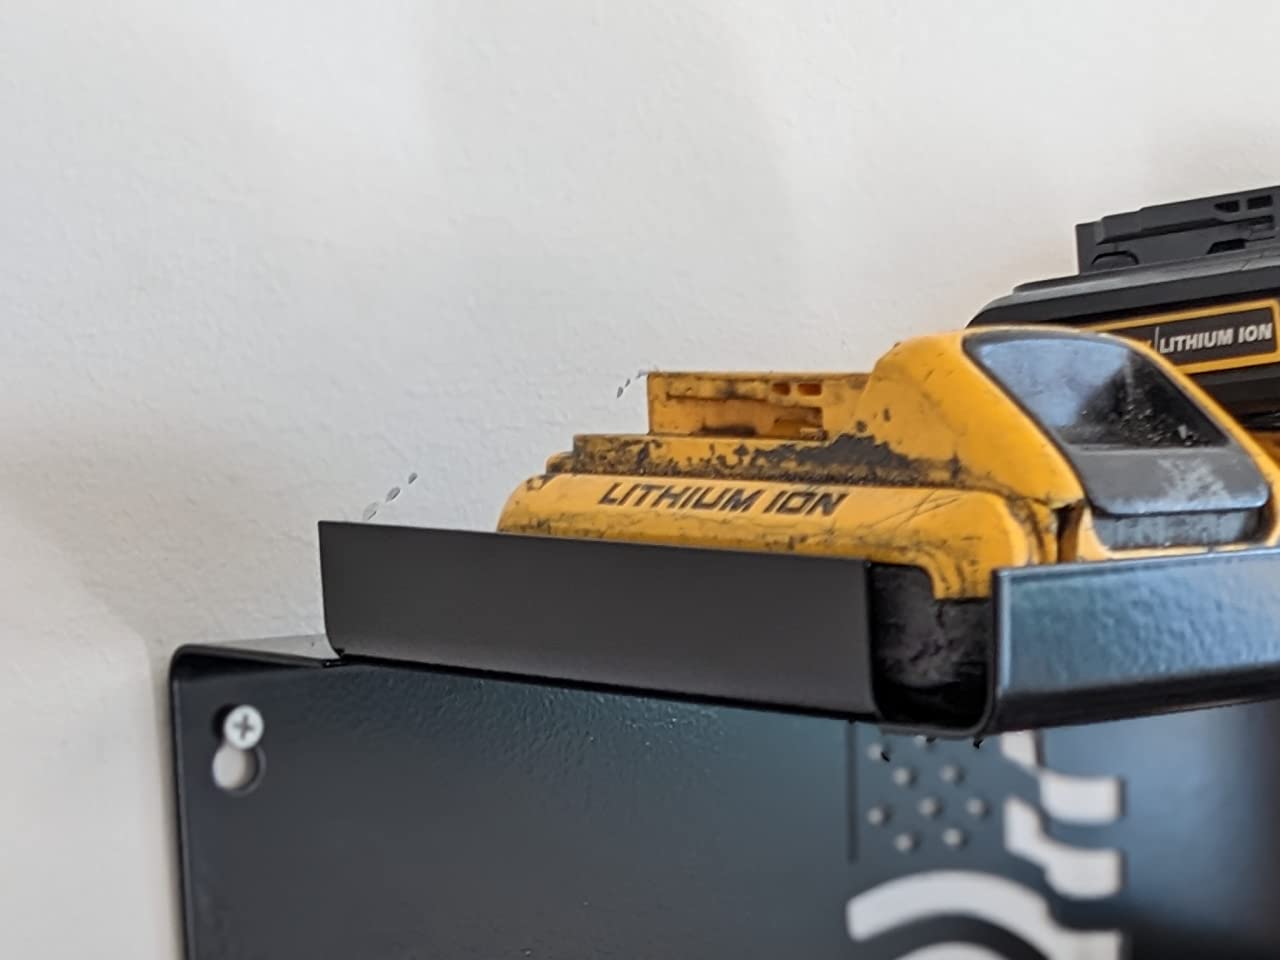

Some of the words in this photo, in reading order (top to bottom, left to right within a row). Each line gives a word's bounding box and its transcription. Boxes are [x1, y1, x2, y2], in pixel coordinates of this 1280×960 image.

[1159, 326, 1234, 353] LITHIUM
[1238, 322, 1273, 343] ION
[597, 481, 763, 515] LITHIUM
[763, 489, 850, 517] ION
